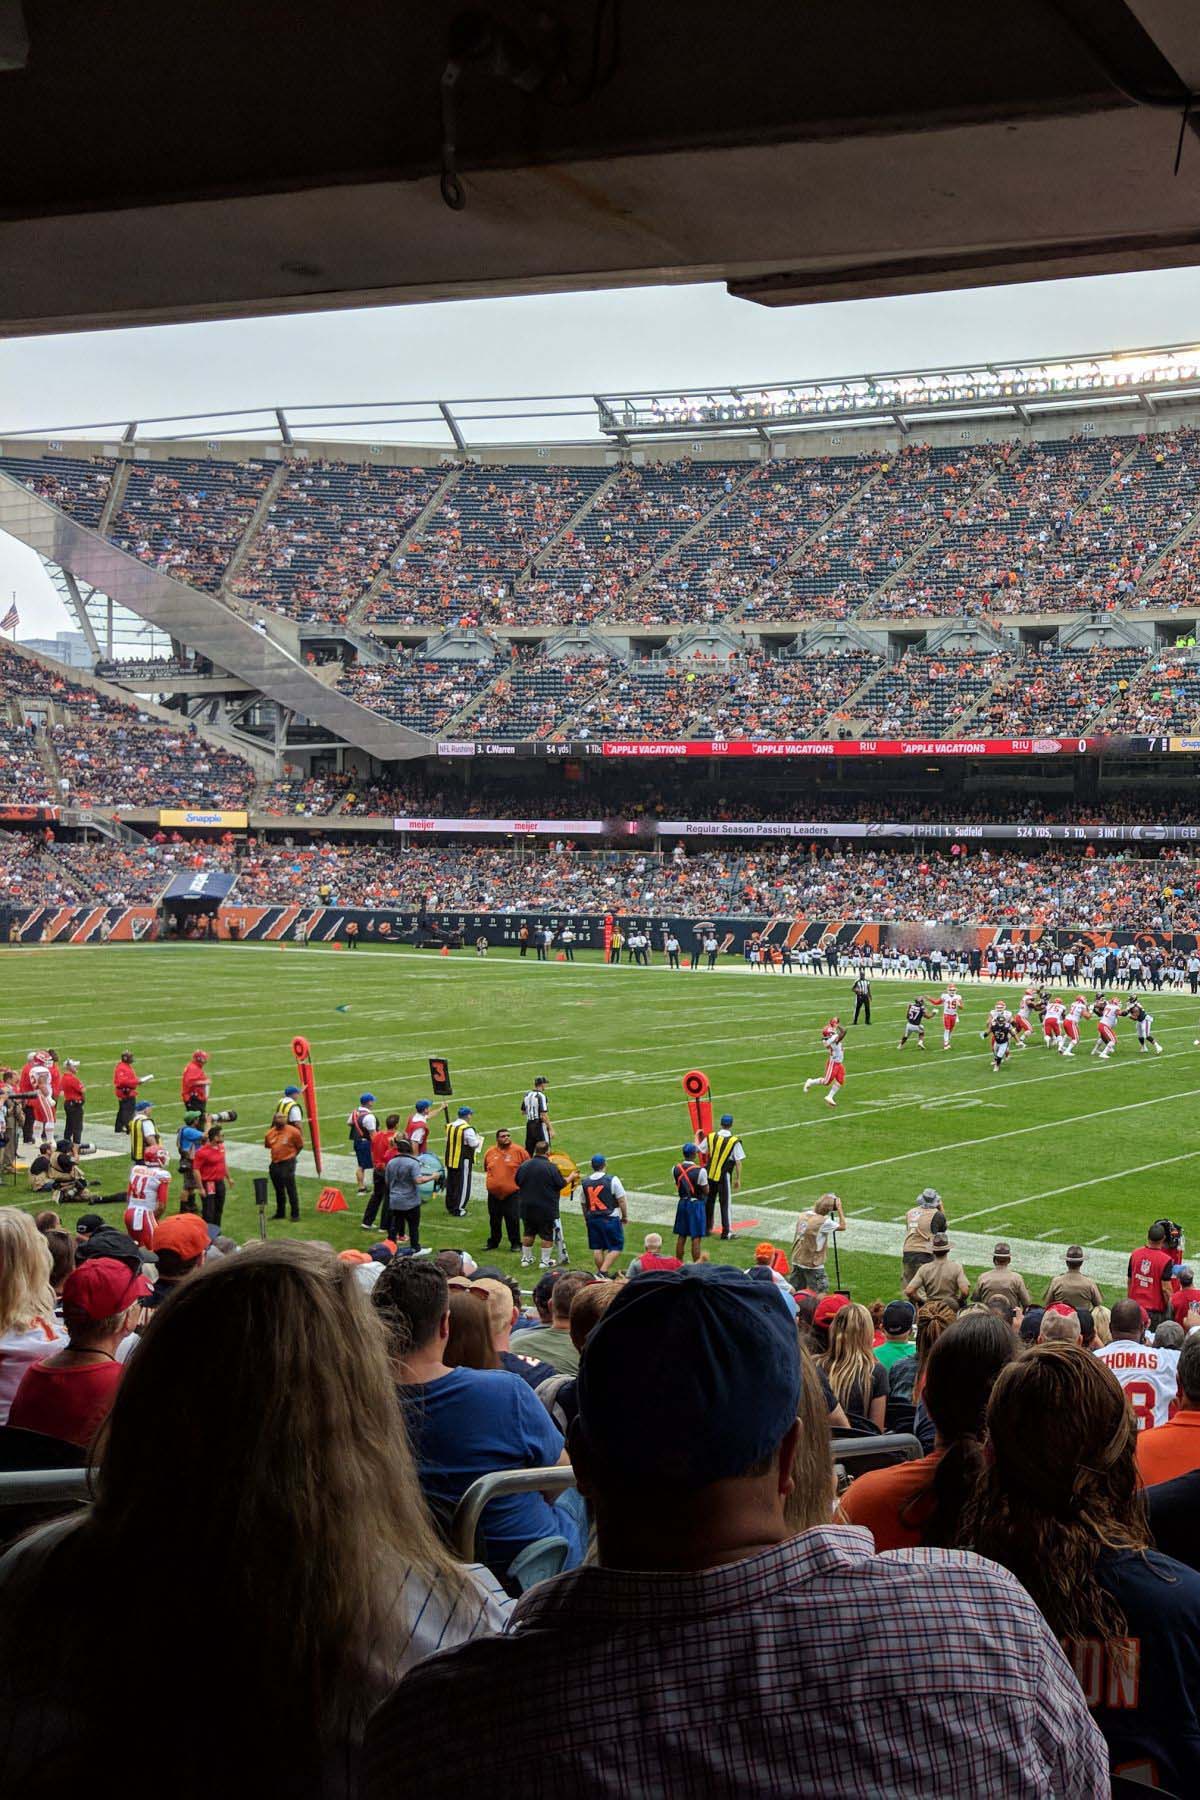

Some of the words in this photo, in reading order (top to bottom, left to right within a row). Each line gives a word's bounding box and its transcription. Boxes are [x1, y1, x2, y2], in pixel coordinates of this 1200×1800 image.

[477, 744, 484, 753] 3.
[546, 745, 556, 753] 54
[558, 746, 569, 755] yds
[612, 745, 638, 754] APPLE
[639, 745, 686, 755] VACATIONS
[711, 743, 728, 751] RIU
[757, 745, 784, 754] APPLE
[785, 745, 834, 754] VACATIONS
[860, 742, 876, 751] RIU
[906, 744, 933, 753] APPLE
[935, 744, 985, 753] VACATIONS
[1012, 741, 1029, 749] RIU
[1078, 739, 1086, 752] 0
[1147, 739, 1156, 752] 7
[185, 813, 222, 823] Snapple
[409, 820, 435, 831] meijer
[514, 821, 538, 832] meijer
[686, 824, 720, 834] Regular
[722, 824, 754, 834] Season
[757, 825, 791, 835] Passing
[793, 825, 829, 834] Leaders
[917, 827, 937, 835] PHI
[955, 827, 983, 837] Sudfeld
[1017, 828, 1032, 837] 524
[1064, 828, 1070, 837] 5
[1098, 828, 1103, 837] 3
[1105, 828, 1118, 837] INT
[1181, 829, 1197, 838] GB
[908, 1008, 920, 1020] 57
[431, 1061, 446, 1082] 3
[131, 1174, 147, 1200] 41
[319, 1191, 337, 1210] 20
[587, 1185, 608, 1211] K
